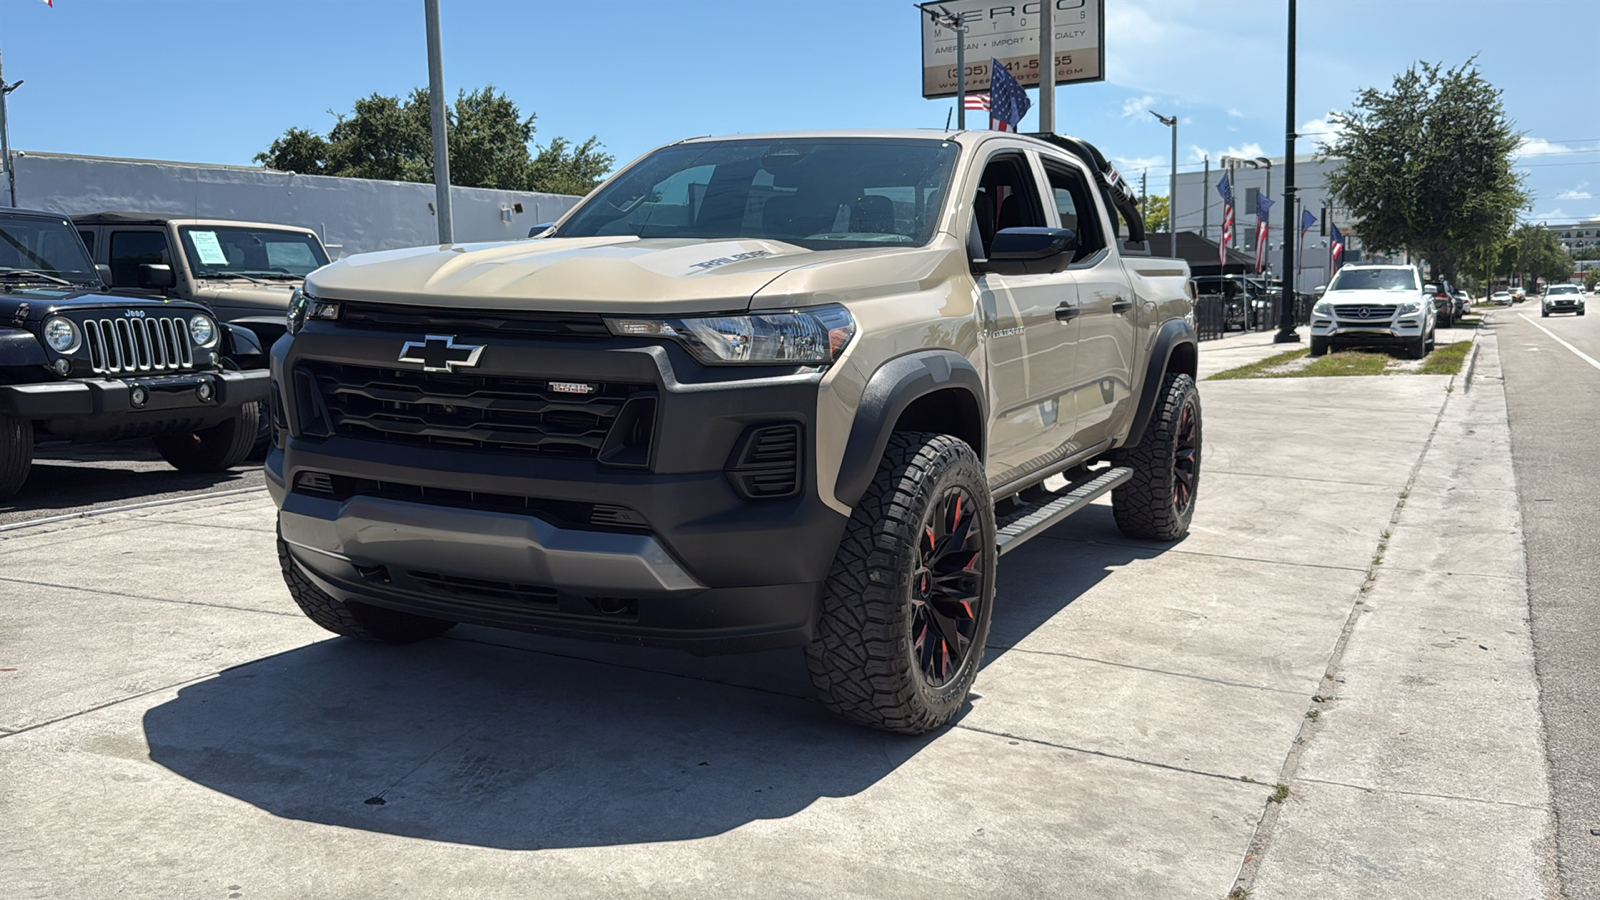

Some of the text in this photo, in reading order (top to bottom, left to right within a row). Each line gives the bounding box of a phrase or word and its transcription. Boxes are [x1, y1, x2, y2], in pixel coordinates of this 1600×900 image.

[992, 37, 1024, 47] IMPORT
[1039, 30, 1086, 42] CIALTY
[1000, 55, 1072, 71] 41-555
[125, 309, 146, 318] Jeep
